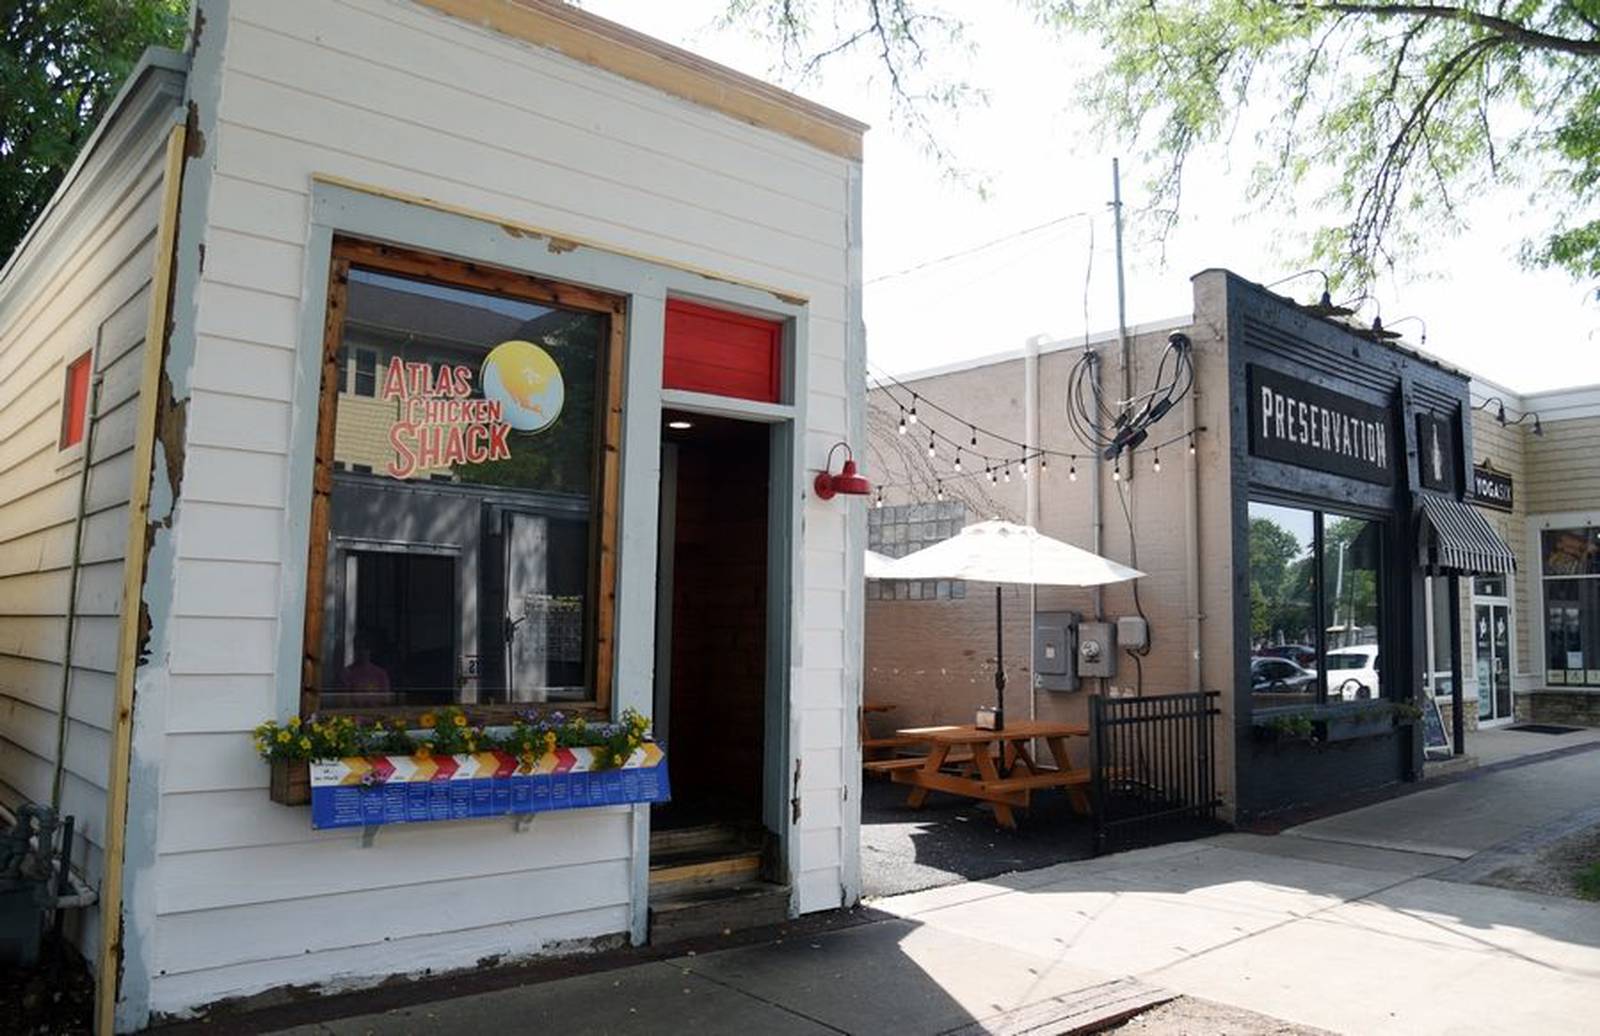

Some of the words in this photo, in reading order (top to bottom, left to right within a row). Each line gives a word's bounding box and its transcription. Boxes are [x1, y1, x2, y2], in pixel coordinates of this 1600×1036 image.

[383, 355, 472, 401] ATLAS
[406, 397, 503, 427] CHICKEN
[1261, 385, 1387, 468] PRESERVATION
[386, 422, 512, 479] SHACK
